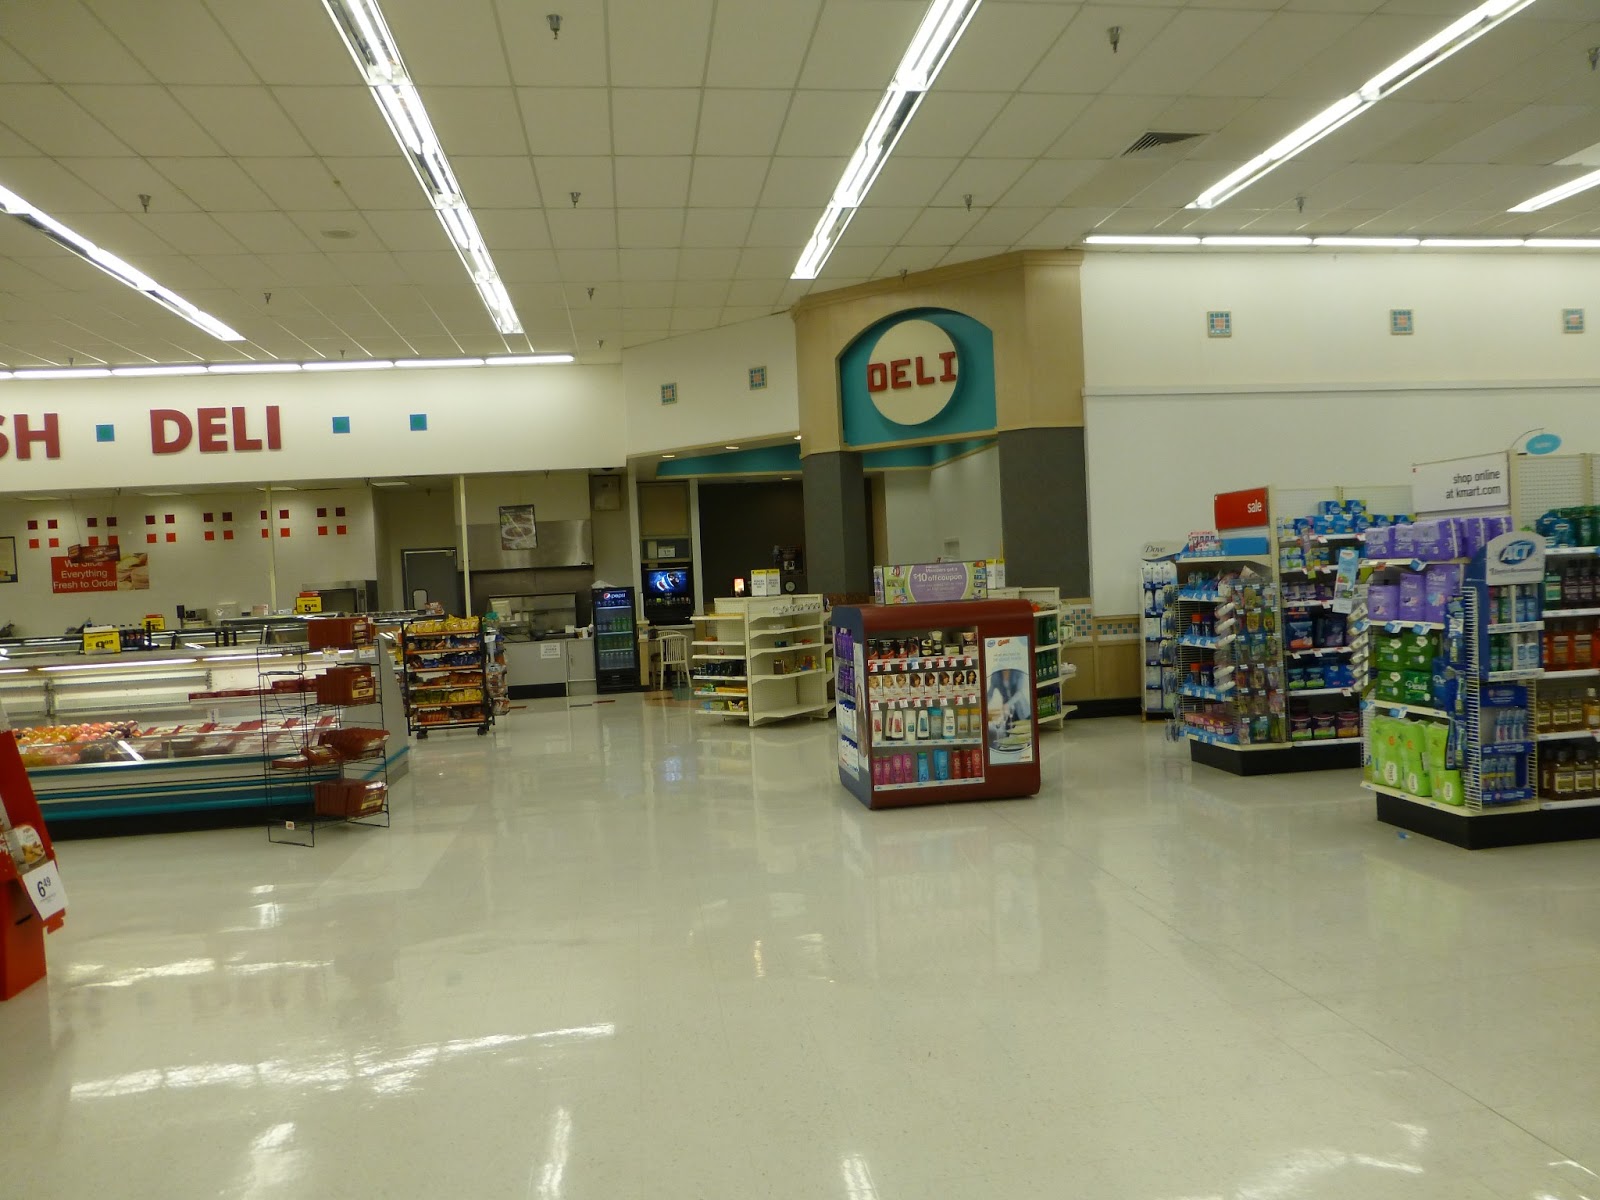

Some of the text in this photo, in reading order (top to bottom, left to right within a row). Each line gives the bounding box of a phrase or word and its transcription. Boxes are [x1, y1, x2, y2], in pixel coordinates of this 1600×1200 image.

[866, 351, 958, 393] DELI
[0, 404, 283, 460] H DELI
[1452, 469, 1501, 485] shop online
[1445, 484, 1501, 499] at kmart.com
[1247, 499, 1262, 513] sale
[1145, 544, 1166, 553] Dove
[1501, 543, 1532, 561] ACT
[61, 568, 108, 580] Everything
[912, 572, 963, 583] $10 off coupon
[53, 579, 117, 590] Fresh to Order
